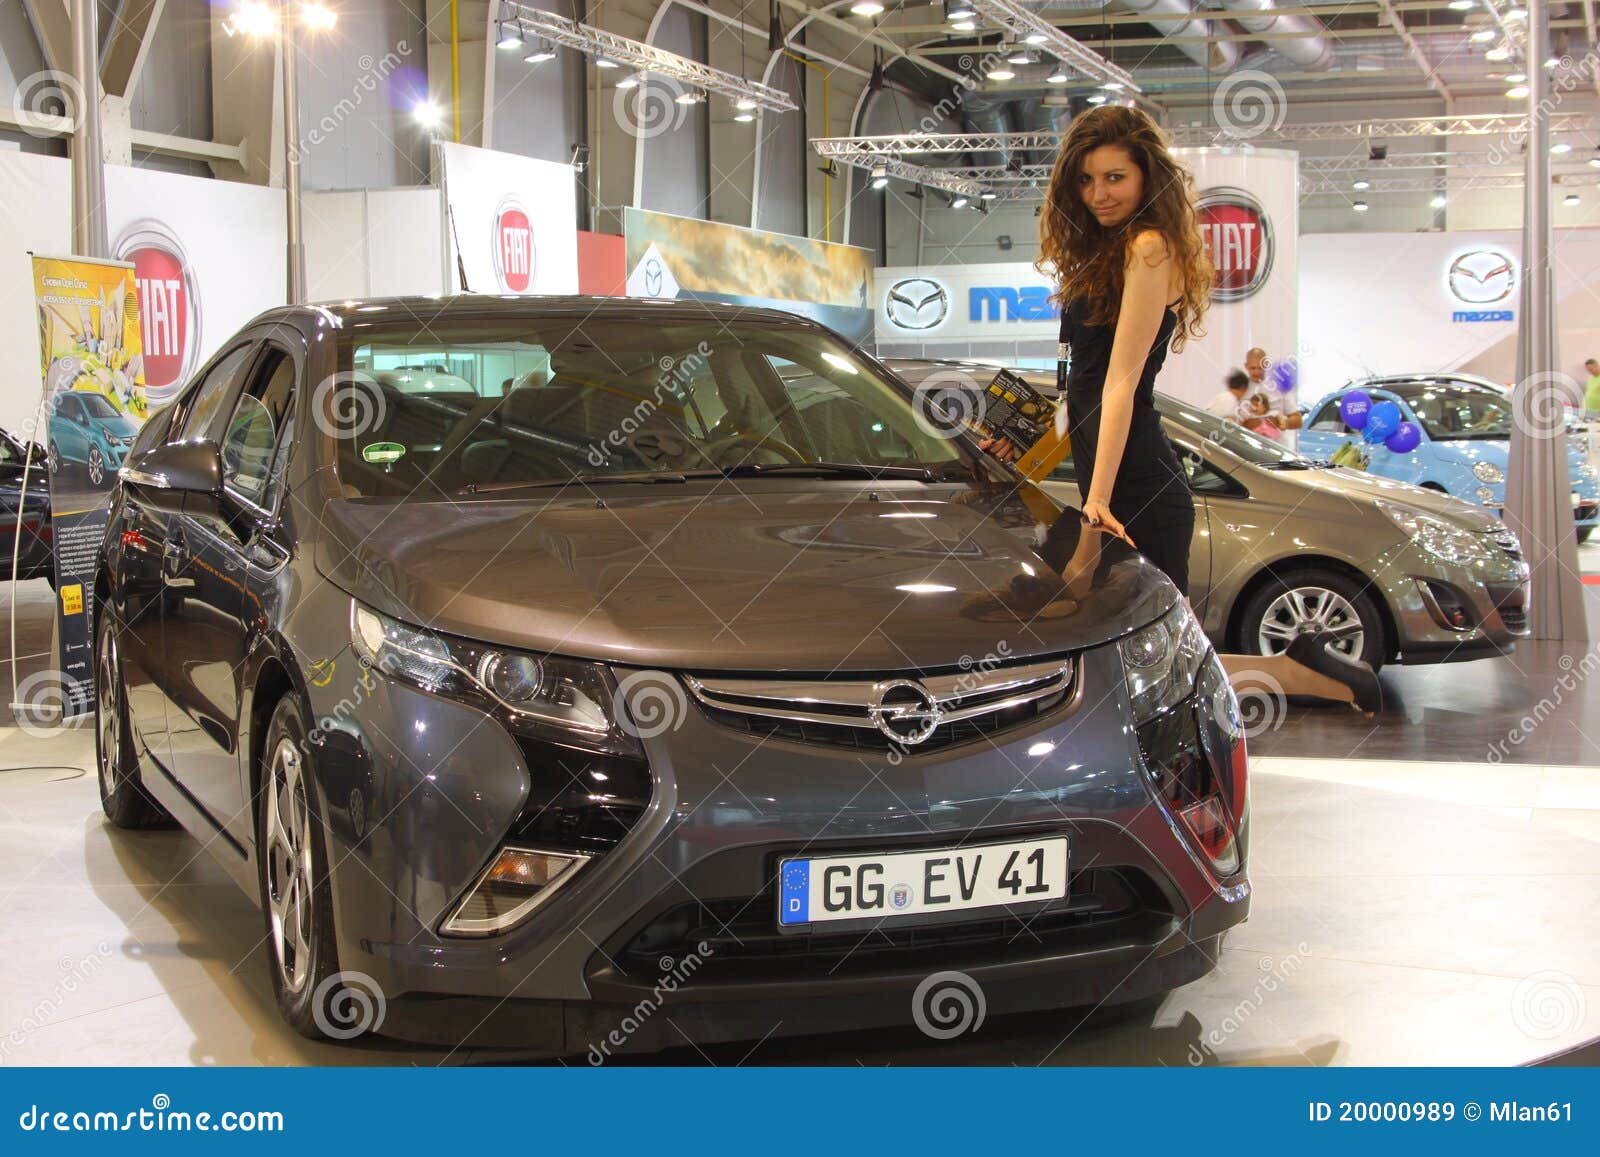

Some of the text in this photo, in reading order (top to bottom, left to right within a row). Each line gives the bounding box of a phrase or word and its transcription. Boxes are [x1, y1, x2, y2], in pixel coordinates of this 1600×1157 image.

[503, 227, 529, 274] FIAT
[969, 286, 1062, 322] ma
[823, 848, 1050, 912] GG EV 41
[790, 898, 801, 912] D
